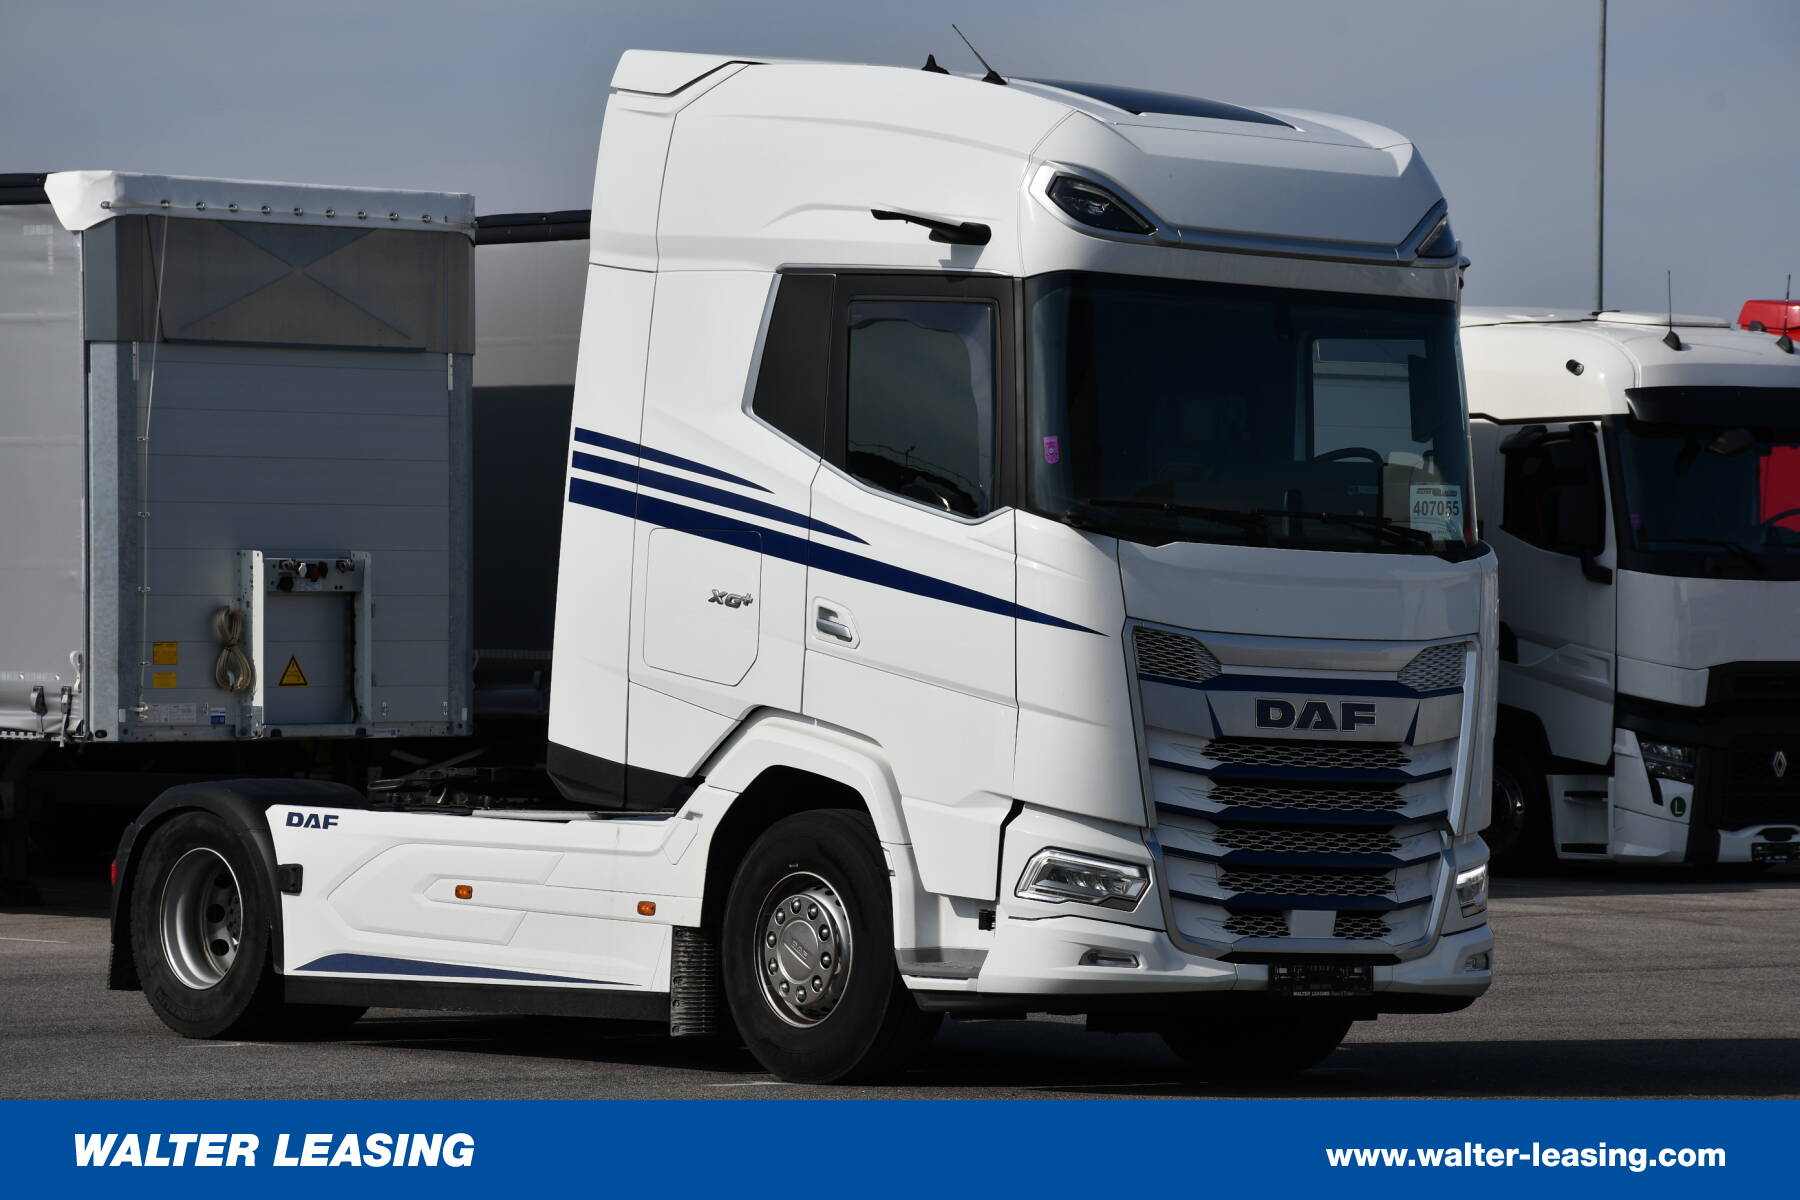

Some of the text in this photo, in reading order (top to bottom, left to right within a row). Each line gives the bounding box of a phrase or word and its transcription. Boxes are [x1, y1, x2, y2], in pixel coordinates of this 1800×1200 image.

[1413, 500, 1460, 516] 407055
[1255, 698, 1377, 731] DAF
[286, 812, 339, 829] DAF
